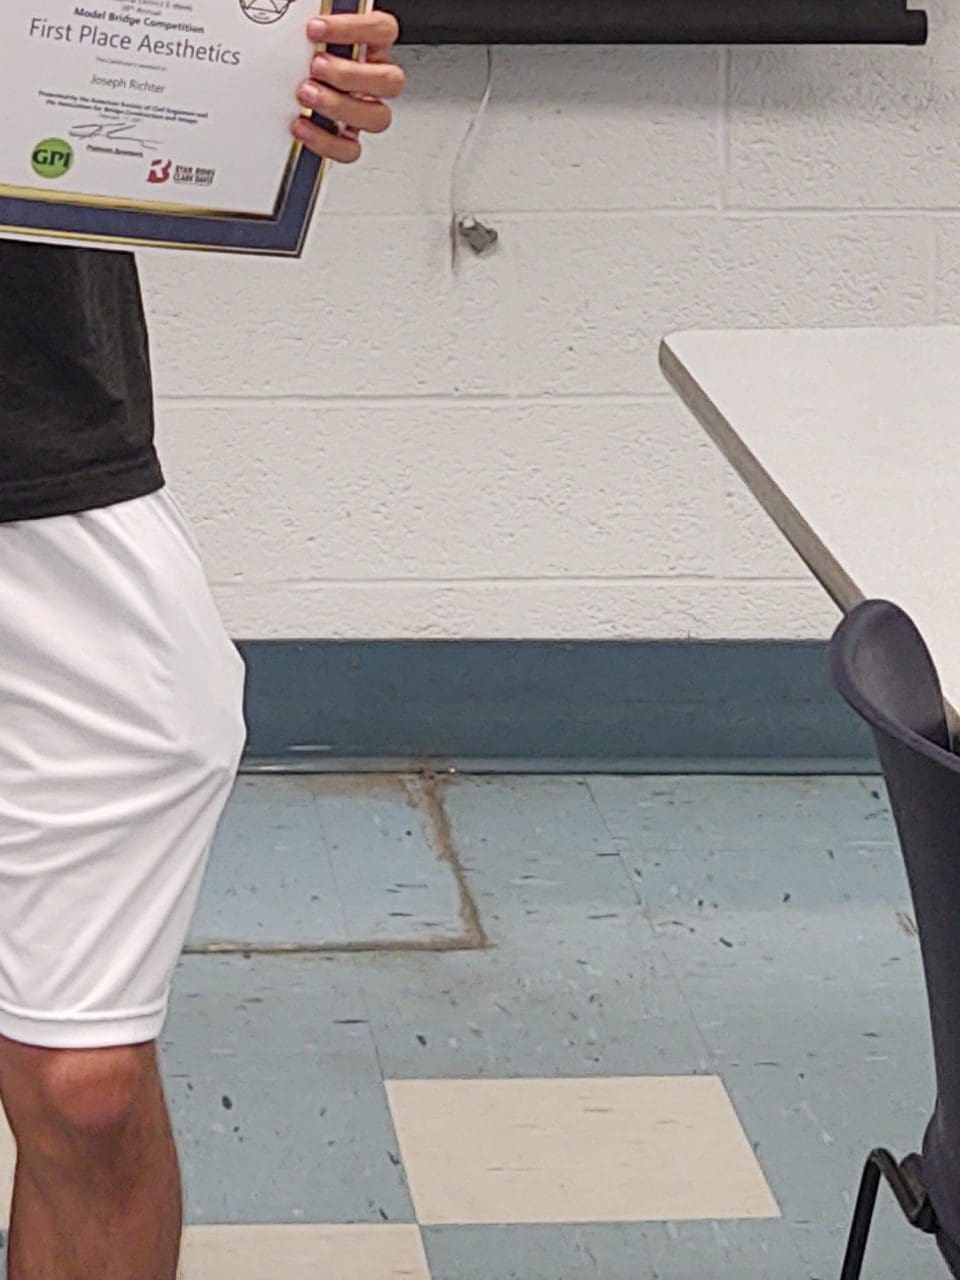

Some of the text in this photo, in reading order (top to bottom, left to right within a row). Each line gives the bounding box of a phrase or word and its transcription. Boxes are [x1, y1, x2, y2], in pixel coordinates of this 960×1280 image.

[73, 7, 205, 34] Model Bridge Competition
[29, 17, 72, 42] First
[79, 25, 132, 50] Place
[137, 33, 241, 66] Aesthetics
[90, 74, 166, 94] Joseph Richter
[31, 148, 71, 168] GPI
